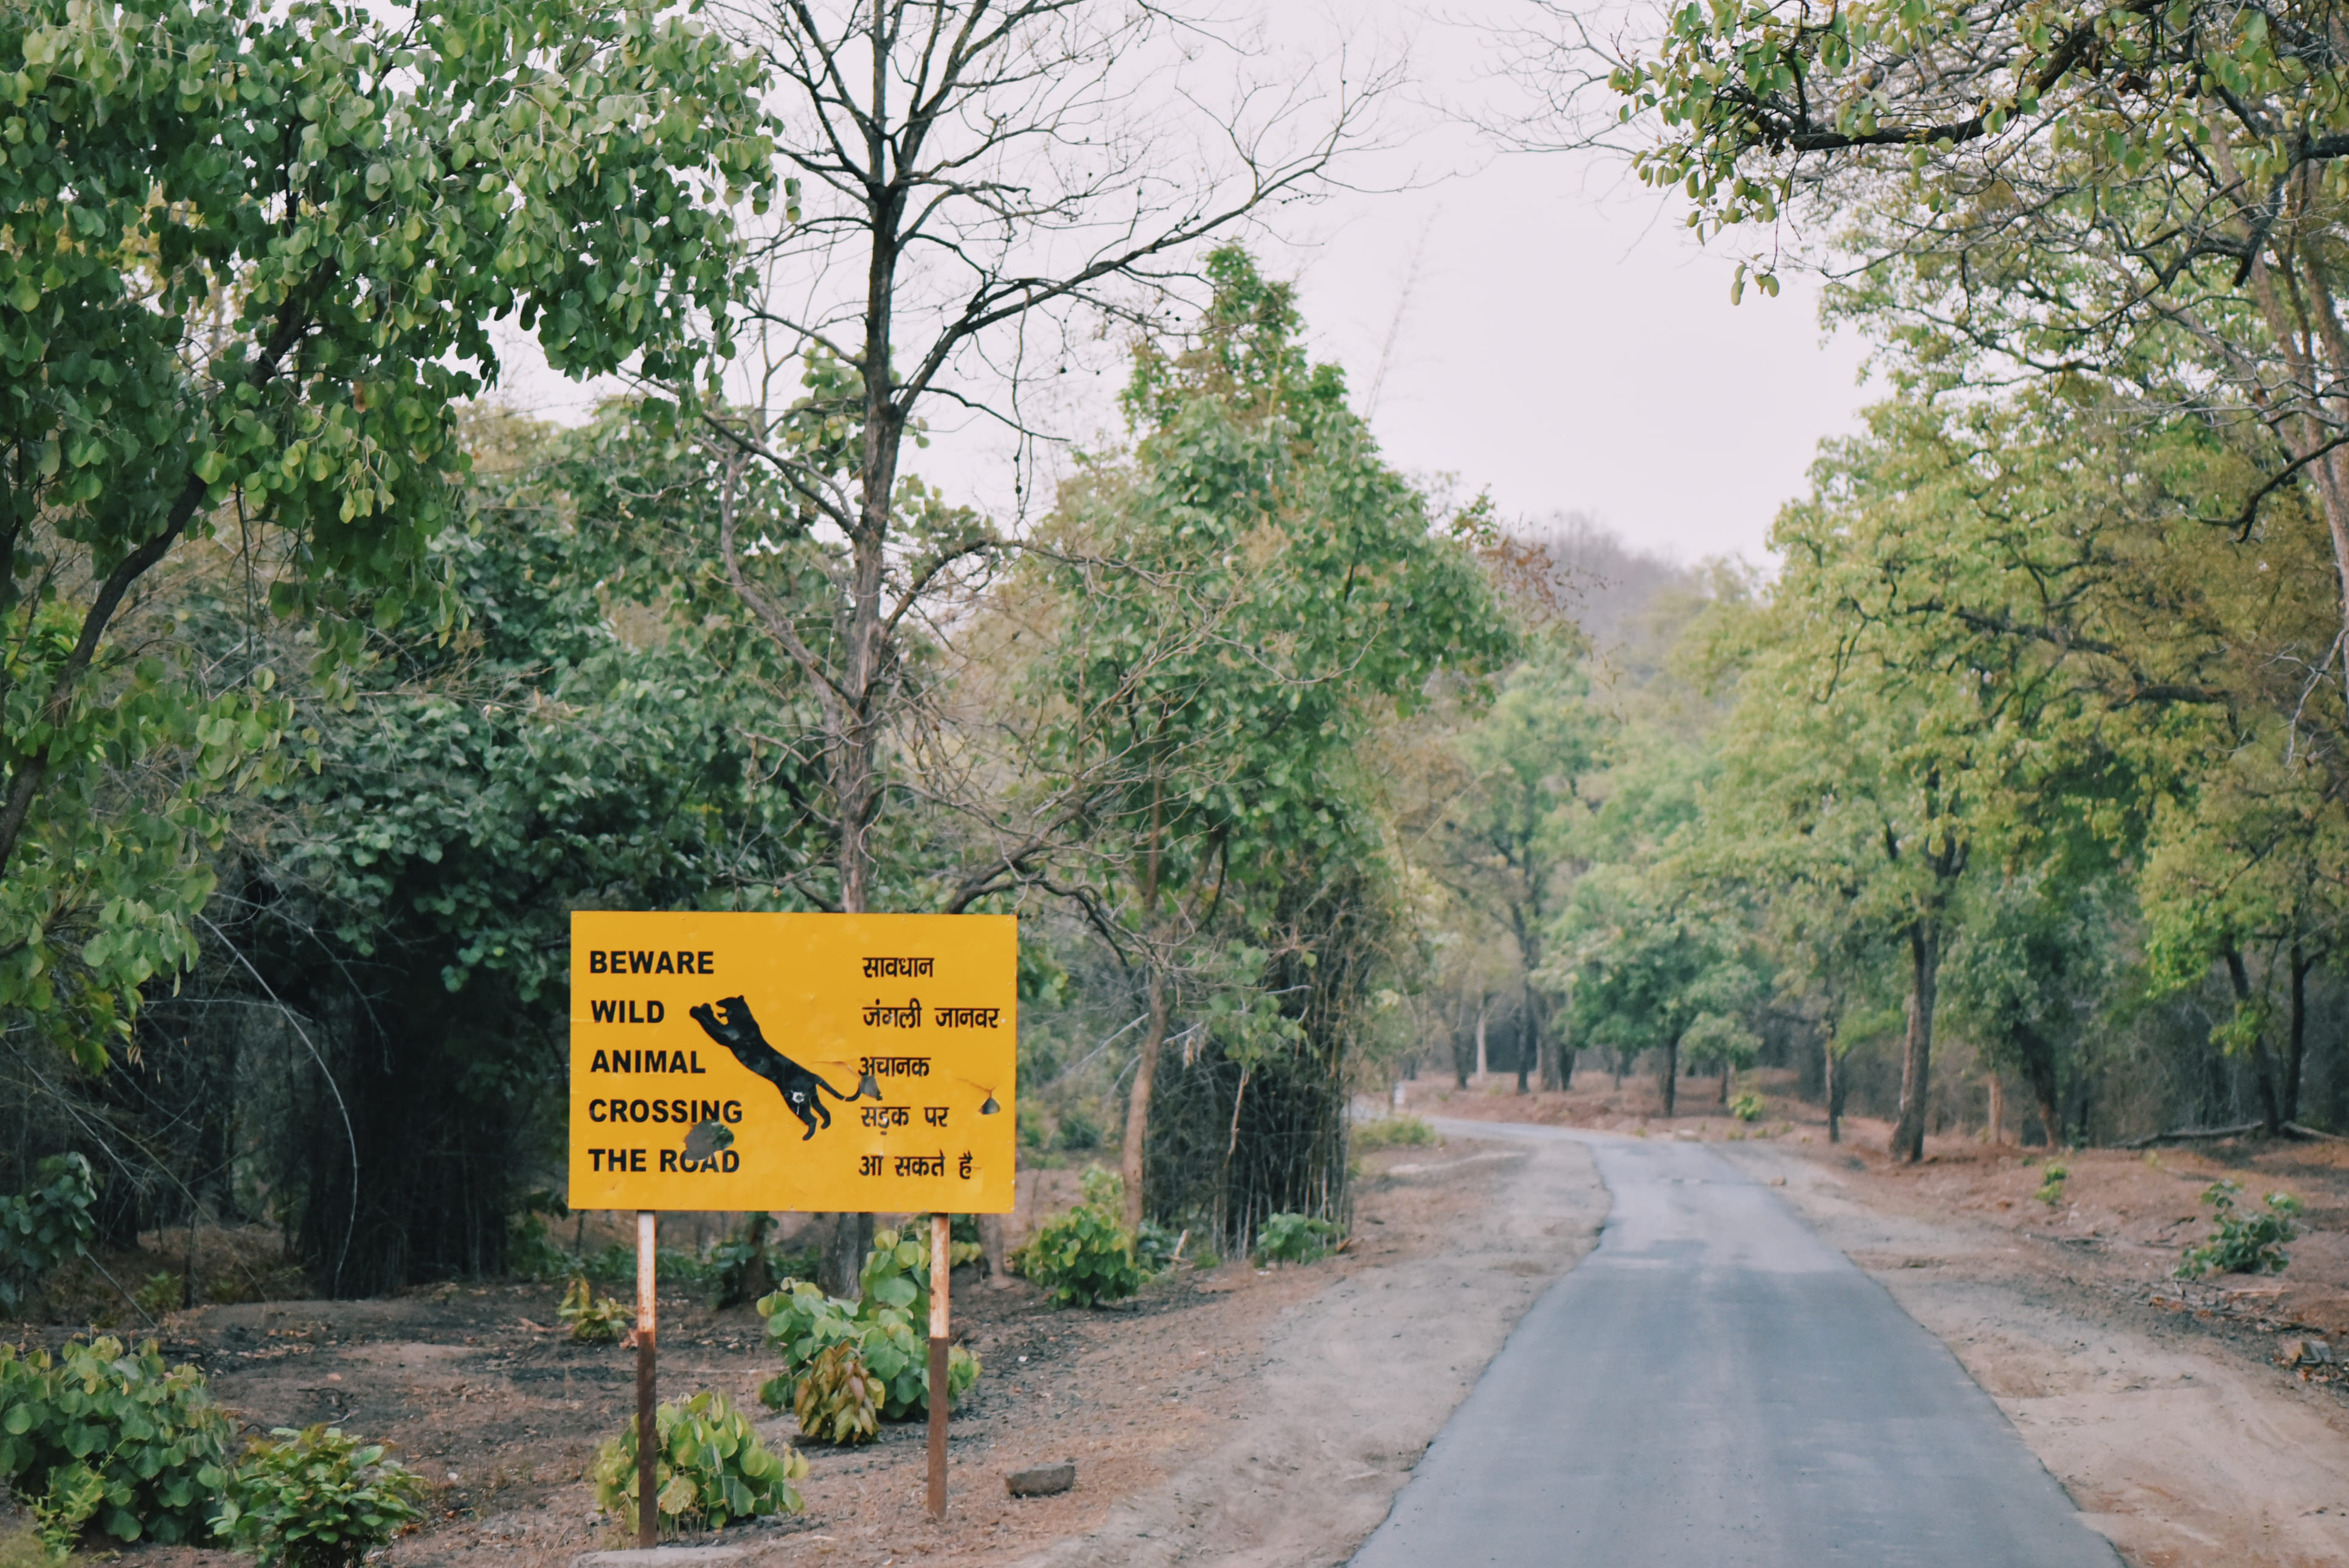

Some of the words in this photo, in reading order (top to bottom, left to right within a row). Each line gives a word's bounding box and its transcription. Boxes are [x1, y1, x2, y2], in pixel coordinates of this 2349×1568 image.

[590, 951, 714, 974] BEWARE
[862, 957, 935, 978] सावधान
[591, 1000, 665, 1023] WILD
[862, 997, 922, 1029] जंगली
[934, 1007, 1001, 1029] जानवर
[590, 1050, 706, 1074] ANIMAL
[858, 1056, 931, 1077] अचानक
[589, 1099, 743, 1123] CROSSING
[861, 1106, 911, 1135] सड़क
[923, 1107, 949, 1128] पर
[588, 1149, 647, 1172] THE
[659, 1149, 740, 1173] ROAD
[859, 1155, 883, 1176] आ
[894, 1148, 945, 1176] सकते
[958, 1150, 973, 1179] है
